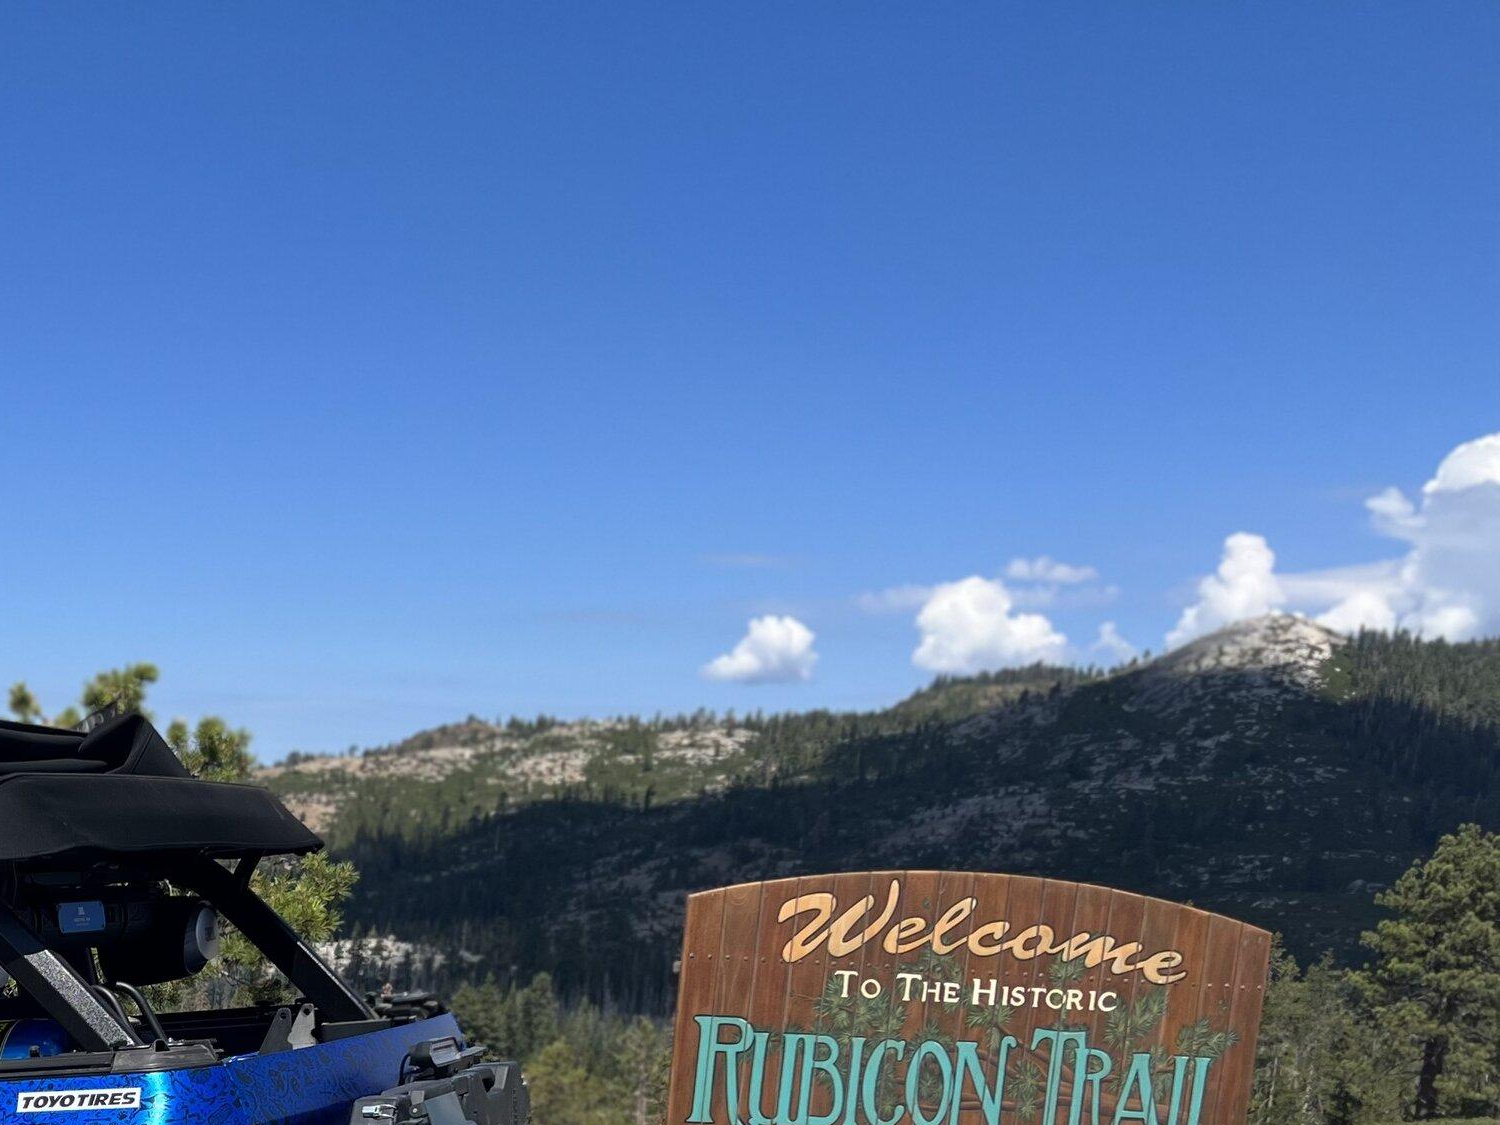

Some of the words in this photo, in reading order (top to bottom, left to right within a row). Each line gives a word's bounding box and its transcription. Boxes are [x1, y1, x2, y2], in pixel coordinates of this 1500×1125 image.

[778, 878, 1187, 984] Welcome
[834, 970, 881, 999] TO
[896, 972, 960, 1002] THE
[972, 978, 1118, 1012] HISTORIC
